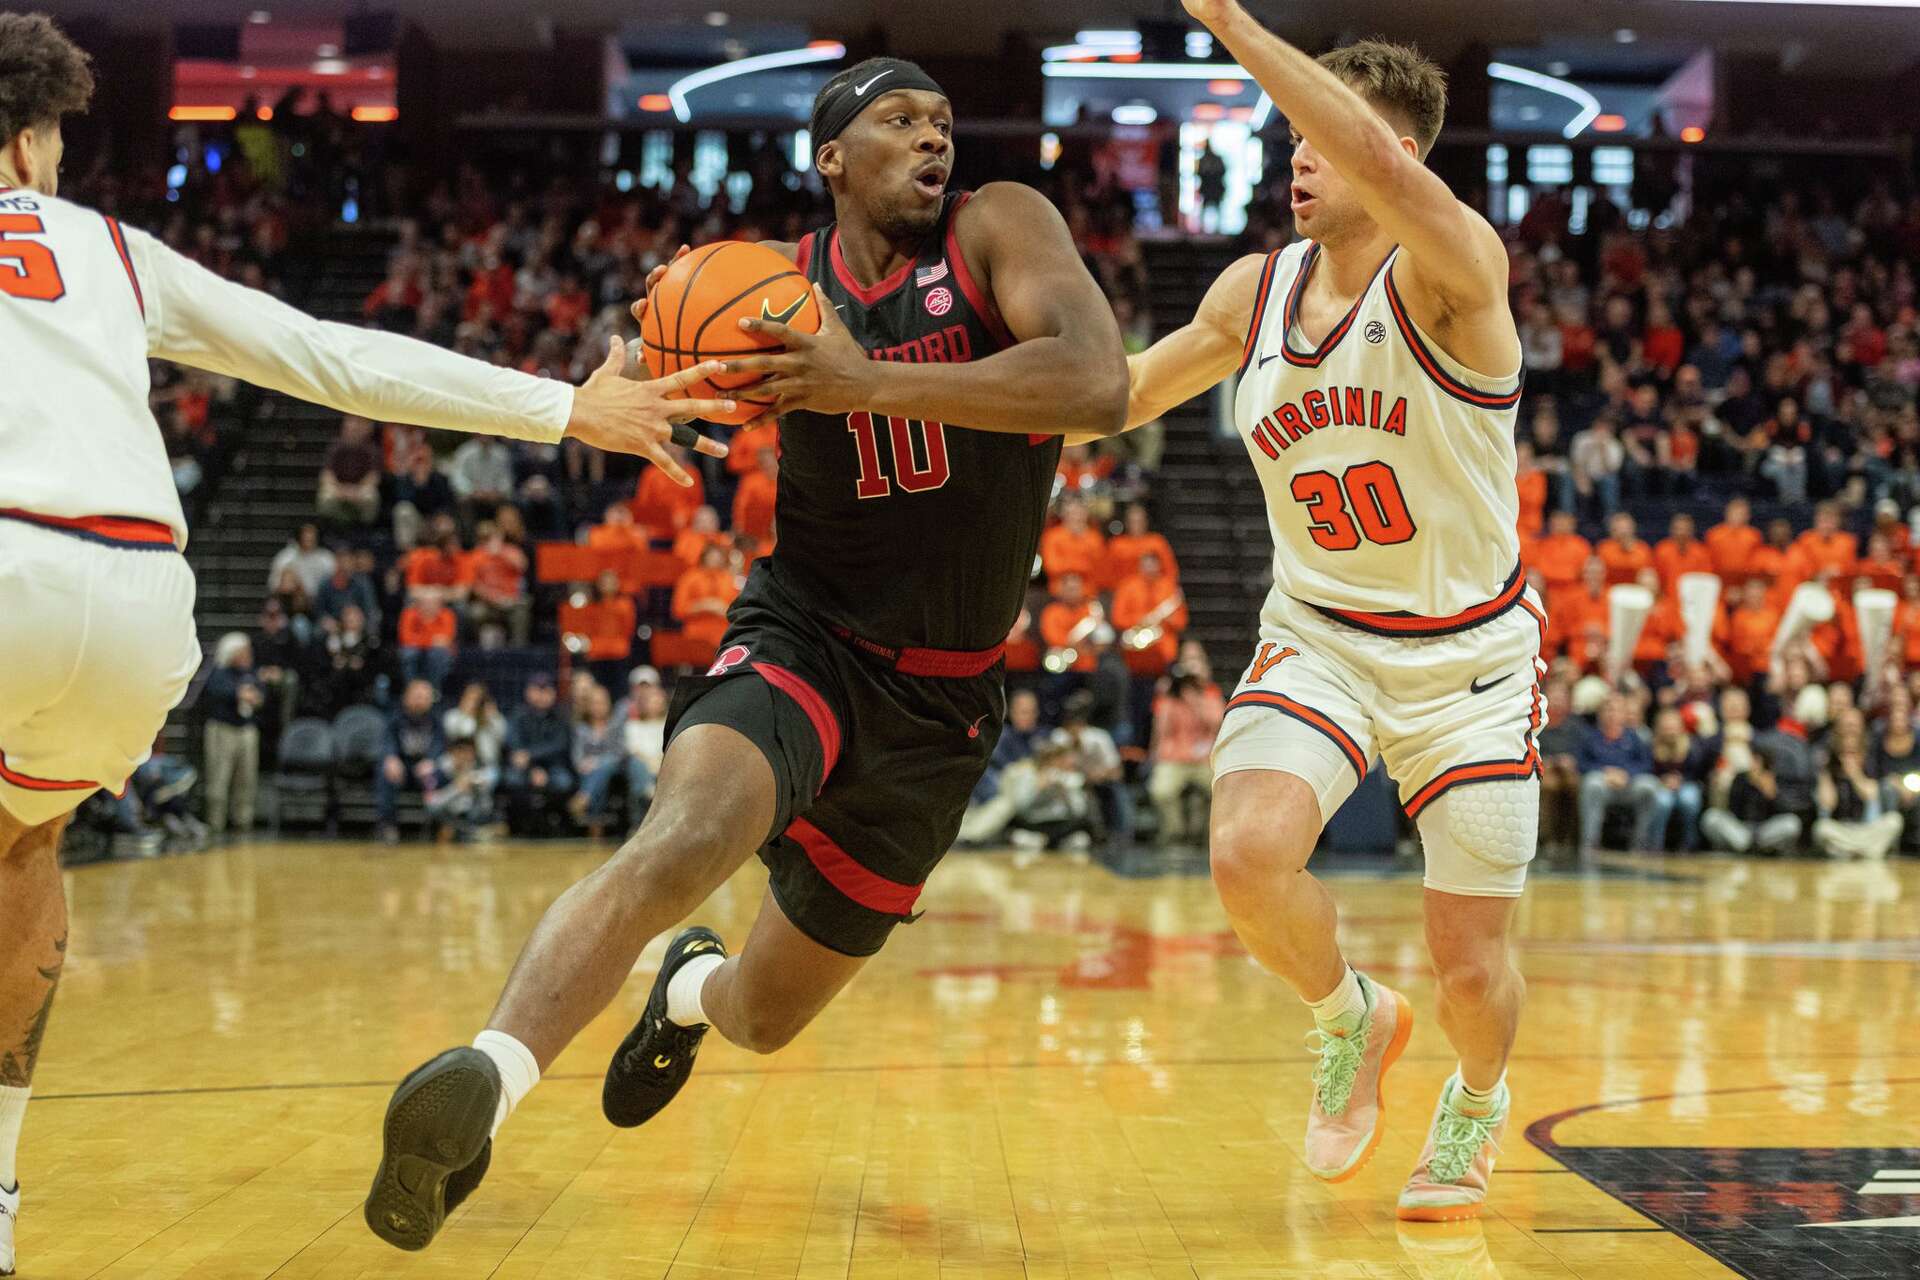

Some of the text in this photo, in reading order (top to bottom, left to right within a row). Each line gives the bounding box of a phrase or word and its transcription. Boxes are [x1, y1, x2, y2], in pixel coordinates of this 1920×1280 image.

[0, 213, 66, 303] 5
[864, 323, 972, 363] ORD
[847, 411, 949, 499] 10
[1251, 386, 1407, 461] VIRGINIA
[1290, 460, 1417, 551] 30
